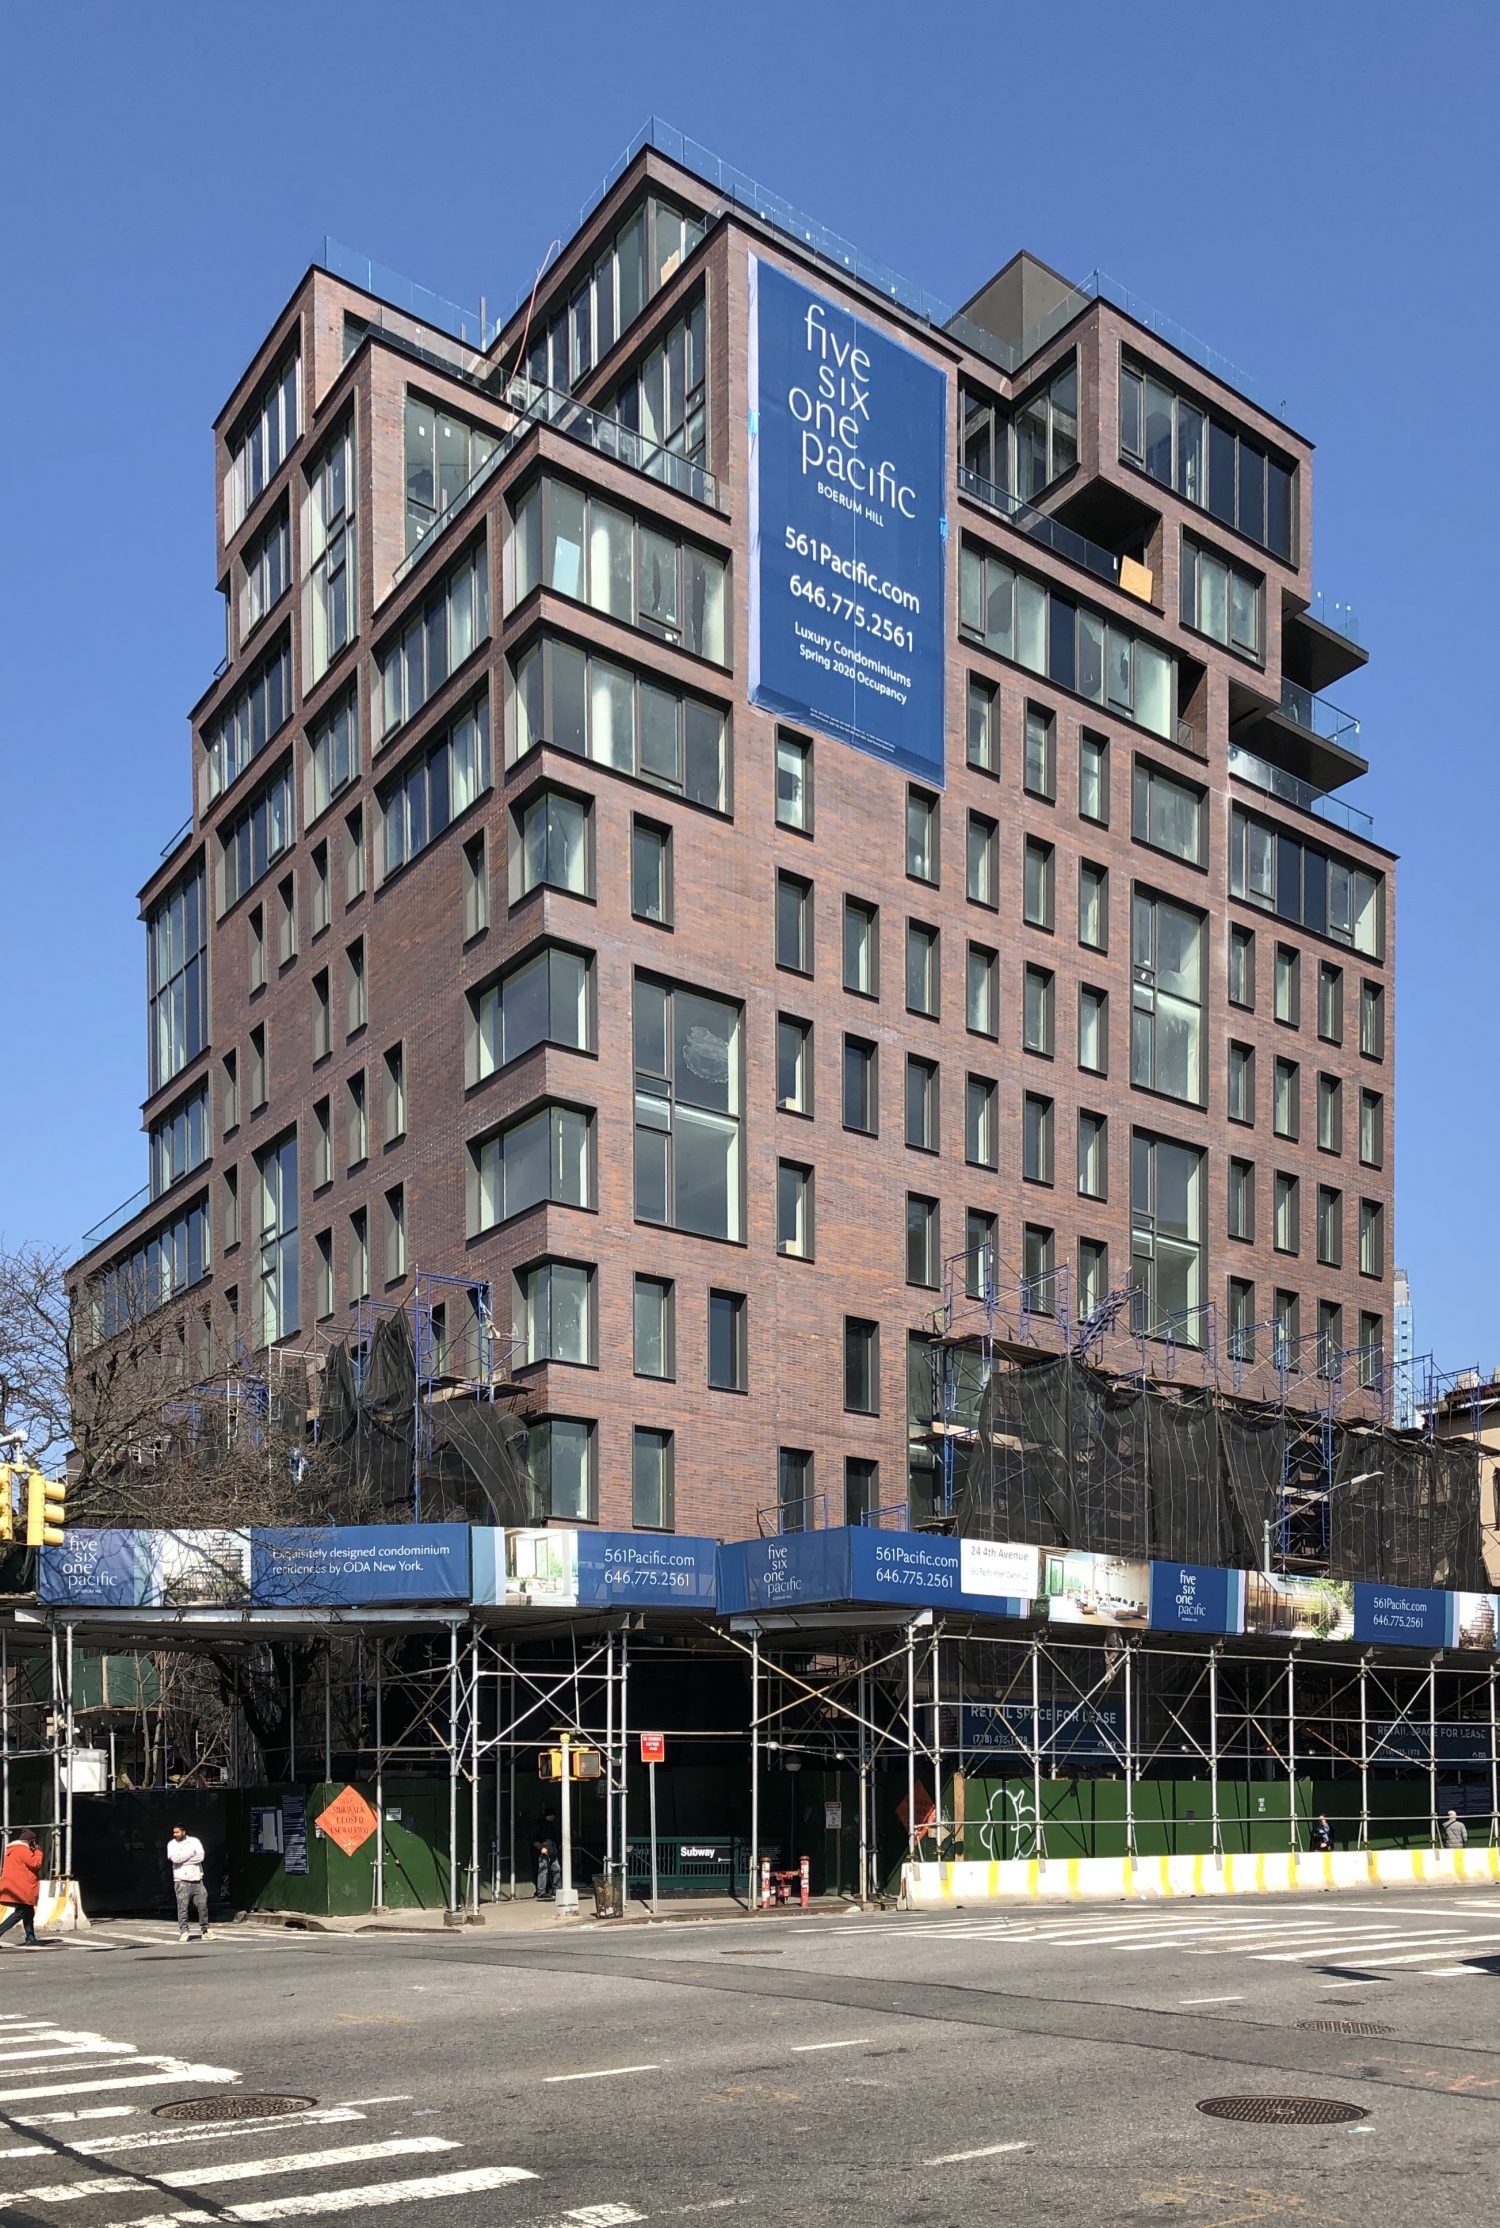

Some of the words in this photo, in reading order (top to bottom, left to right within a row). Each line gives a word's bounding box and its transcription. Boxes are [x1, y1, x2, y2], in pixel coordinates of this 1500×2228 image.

[804, 304, 871, 382] five
[818, 365, 870, 421] six
[788, 387, 859, 449] one
[802, 430, 916, 519] pacific
[817, 481, 862, 515] BOERUM
[865, 507, 884, 527] HILL
[785, 526, 920, 614] 561Pacific.com
[789, 574, 913, 653] 646.775.2561
[794, 621, 831, 651] Luxury
[833, 640, 912, 688] Condominiums
[799, 643, 831, 670] Spring
[833, 659, 855, 679] 2020
[857, 671, 907, 706] Occupancy
[70, 1535, 97, 1551] five
[75, 1552, 97, 1562] six
[329, 1546, 376, 1560] designed
[378, 1545, 450, 1556] condominium
[604, 1548, 695, 1567] 561Pacific.com
[768, 1543, 788, 1560] five
[875, 1546, 959, 1568] 561Pacific.com
[971, 1545, 981, 1556] 24
[983, 1547, 996, 1558] 4th
[998, 1548, 1029, 1561] Avenue
[62, 1563, 92, 1574] one
[329, 1562, 341, 1576] by
[343, 1561, 371, 1573] ODA
[373, 1561, 396, 1572] New
[398, 1560, 424, 1571] York.
[772, 1559, 788, 1571] six
[68, 1571, 118, 1590] pacific
[604, 1569, 689, 1587] 646.775.2561
[763, 1570, 785, 1583] one
[875, 1567, 953, 1589] 646.775.2561
[1180, 1569, 1196, 1585] five
[767, 1575, 802, 1599] pacific
[1182, 1585, 1196, 1595] six
[1175, 1594, 1193, 1605] one
[1373, 1597, 1427, 1612] 561Pacific.com
[1177, 1602, 1207, 1618] pacific
[1373, 1613, 1424, 1629] 646.775.2561
[970, 1706, 1013, 1719] RETIL
[1016, 1708, 1052, 1721] SPCE
[1056, 1709, 1079, 1722] FOR
[972, 1734, 993, 1745] (78)
[1377, 1725, 1409, 1737] REAIL
[1440, 1728, 1458, 1738] FOR
[336, 1816, 364, 1825] CLOSED
[680, 1846, 715, 1858] Subway
